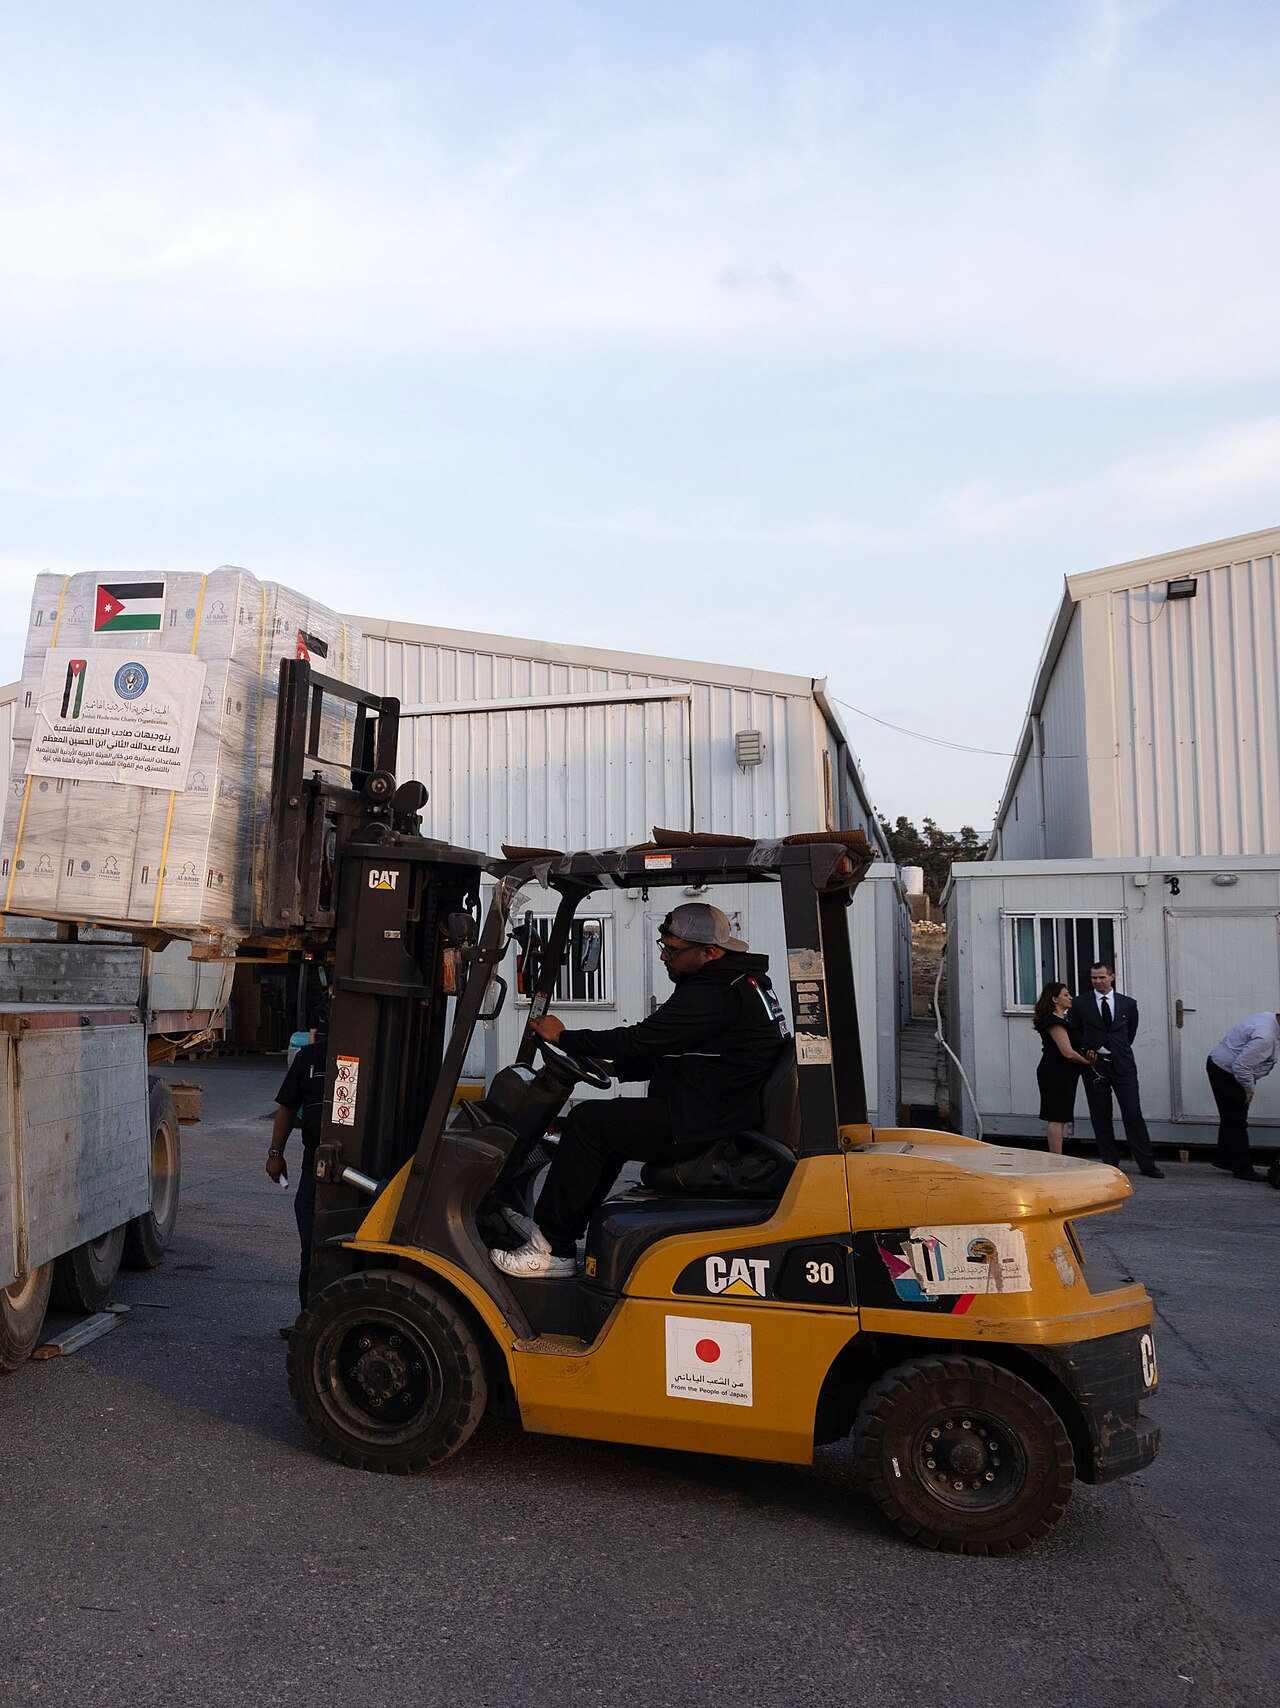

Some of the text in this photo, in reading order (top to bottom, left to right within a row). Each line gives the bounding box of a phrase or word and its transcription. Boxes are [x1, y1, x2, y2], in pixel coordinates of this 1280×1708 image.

[53, 724, 171, 743] بتوجيهات صاحب الجلالة الهاشمية
[35, 745, 60, 754] الهاشمية
[42, 734, 180, 754] الملك عبدالله الثاني ابن الحسين المعظم
[42, 755, 52, 763] غزة
[155, 758, 181, 767] مساعدات
[368, 869, 399, 890] CAT
[705, 1256, 770, 1297] CAT
[806, 1261, 834, 1284] 30
[674, 1372, 705, 1384] الياباني
[706, 1376, 730, 1386] الشعب
[670, 1383, 687, 1391] From
[699, 1387, 720, 1395] People
